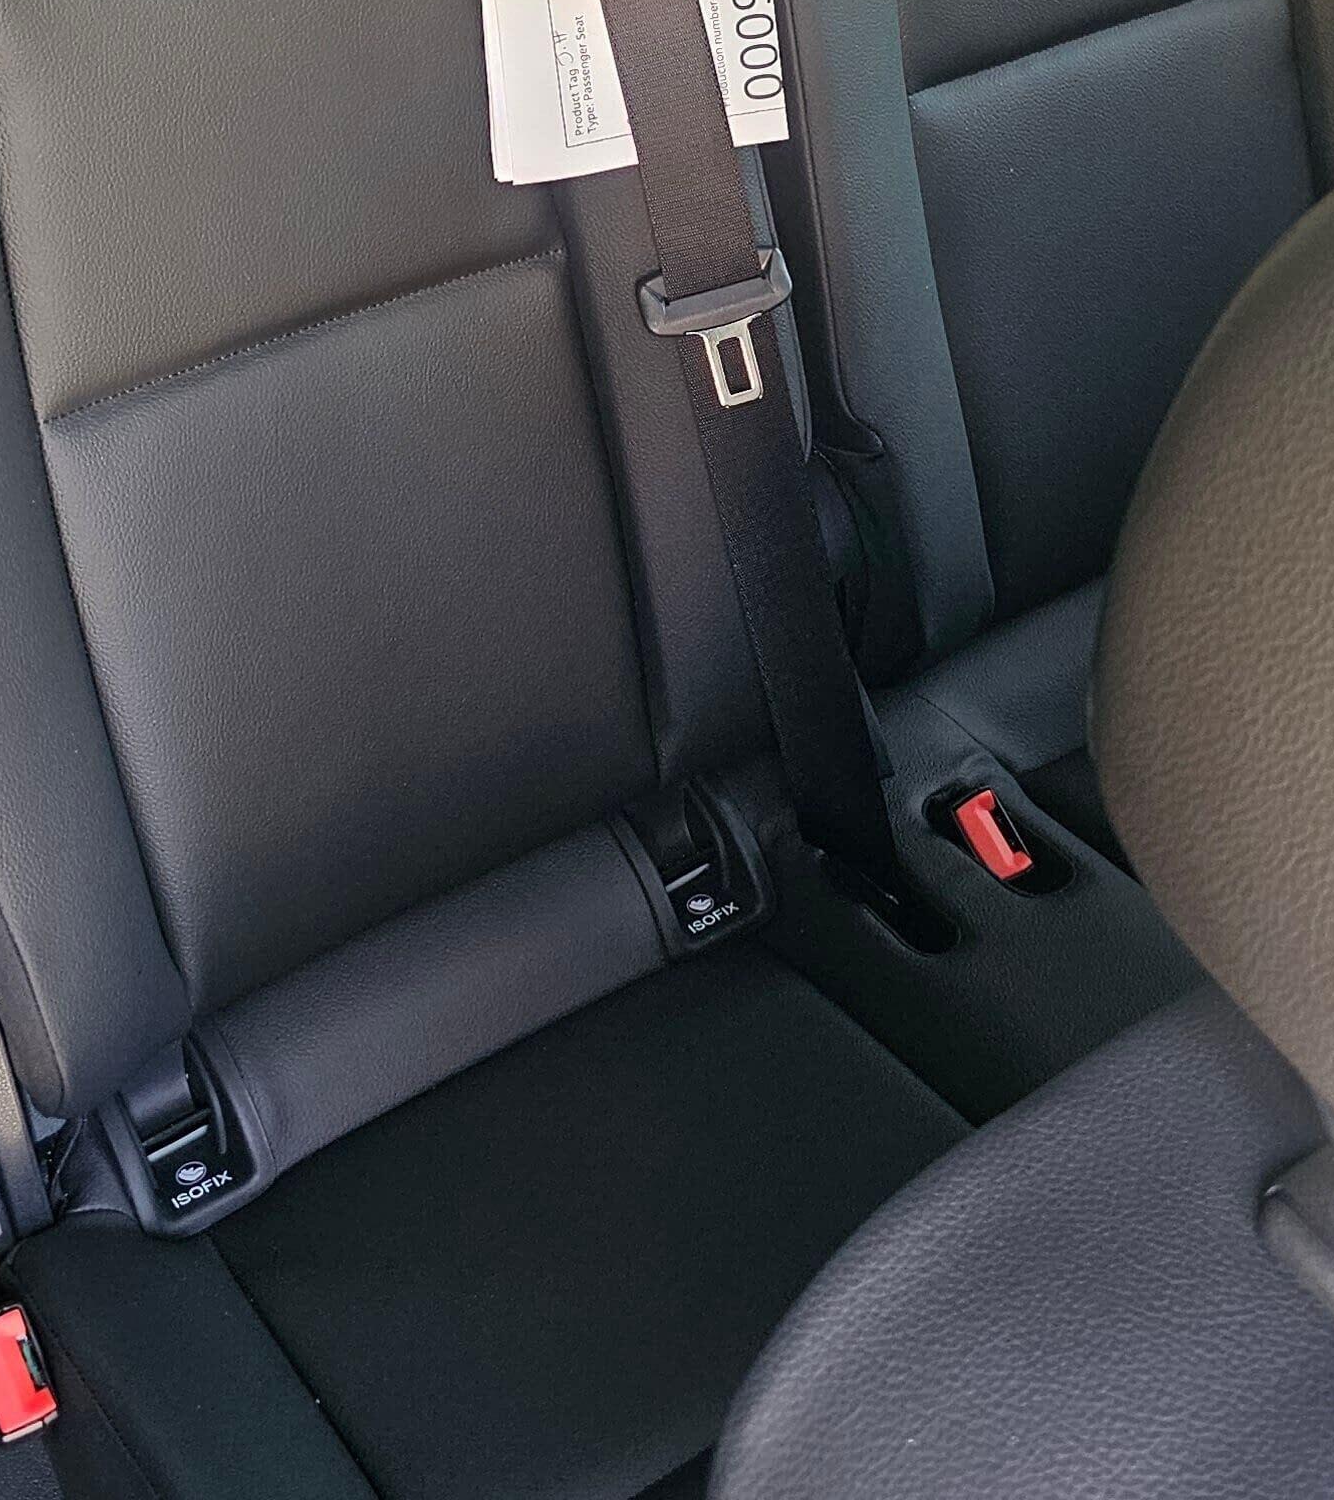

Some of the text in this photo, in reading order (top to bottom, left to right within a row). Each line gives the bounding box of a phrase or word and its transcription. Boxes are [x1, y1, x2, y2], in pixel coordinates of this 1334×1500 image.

[710, 1, 722, 45] number
[575, 15, 599, 134] Type: Passenger Seat
[569, 68, 584, 136] Product Tag
[688, 901, 740, 934] ISOFIX
[171, 1170, 233, 1209] ISOFIX
